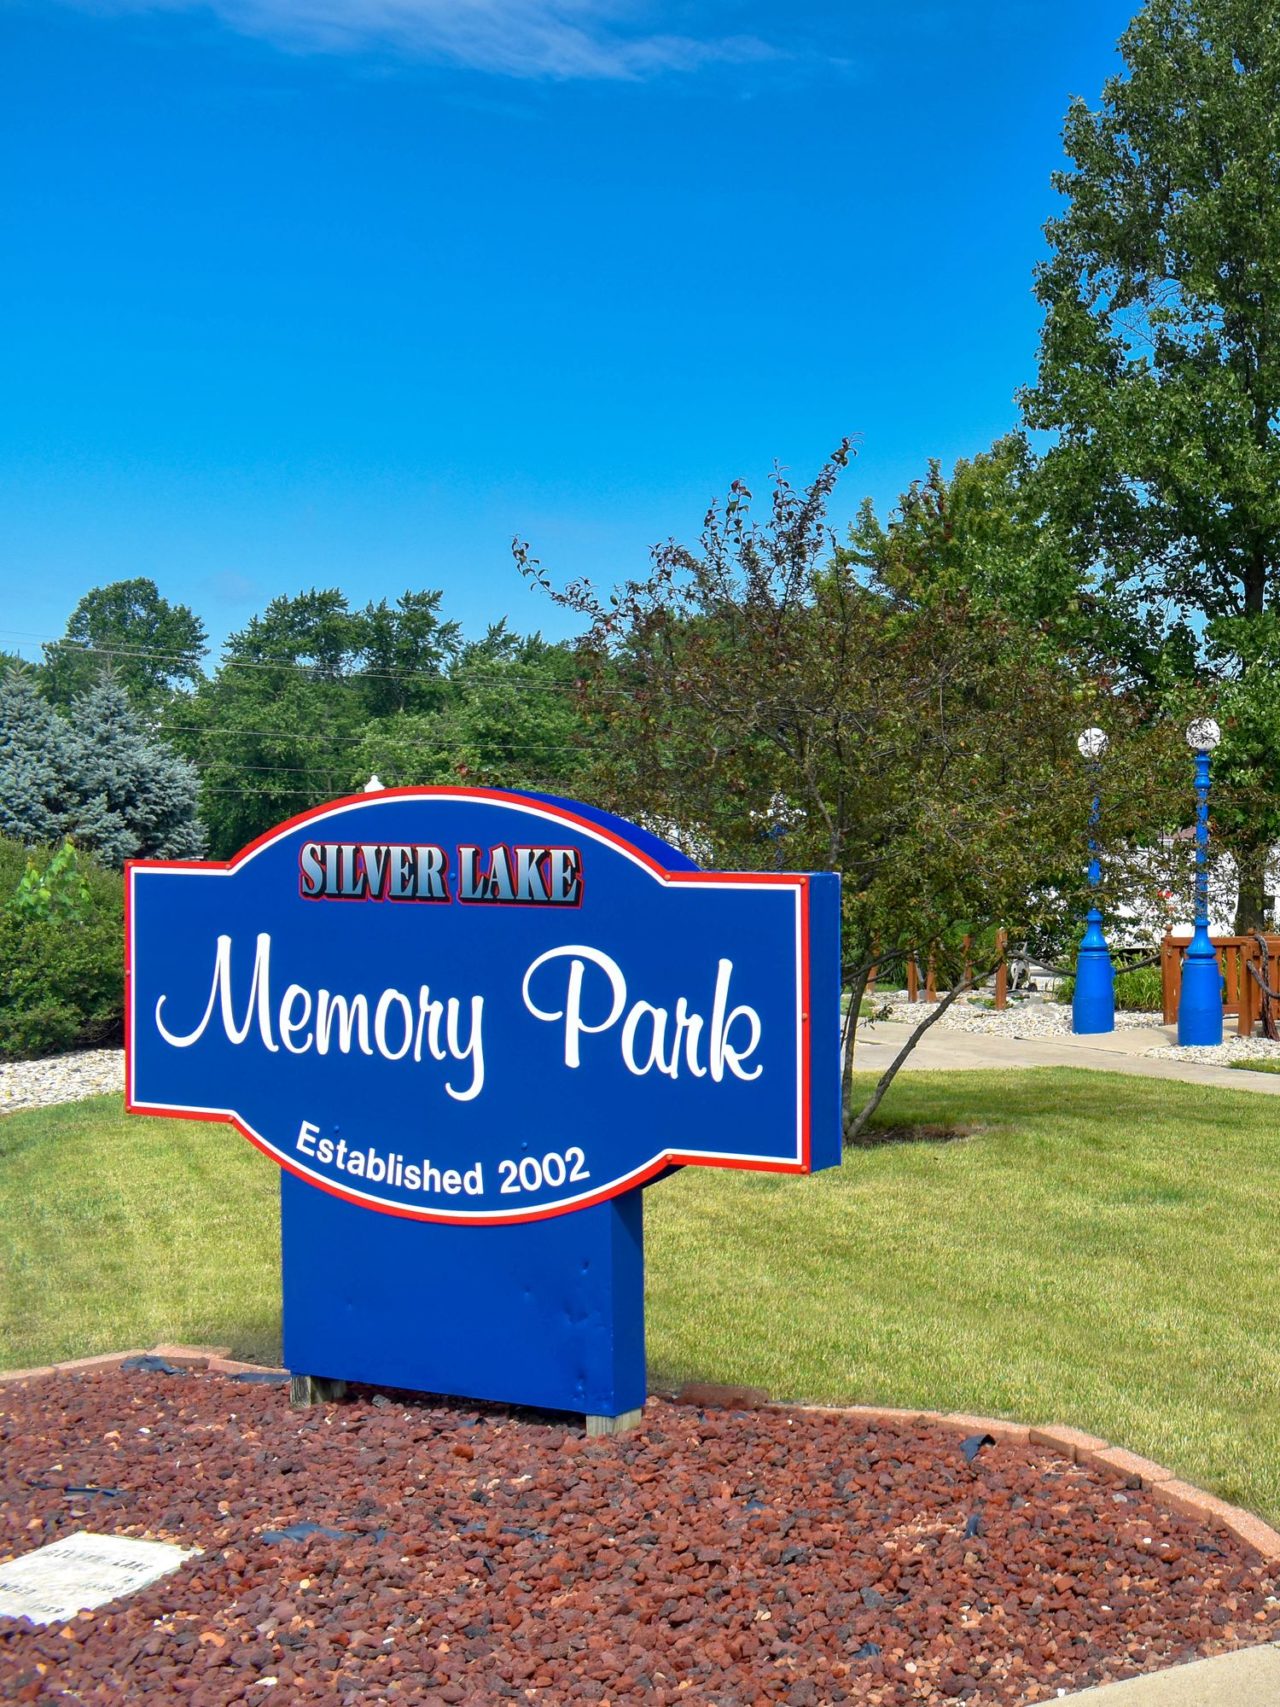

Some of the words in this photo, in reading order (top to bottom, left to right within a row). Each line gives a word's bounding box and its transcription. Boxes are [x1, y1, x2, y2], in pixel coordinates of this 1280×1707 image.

[300, 842, 451, 903] SILVER
[457, 843, 584, 908] LAKE
[155, 932, 485, 1102] Memory
[522, 944, 763, 1083] Park
[296, 1120, 484, 1195] Established
[498, 1146, 591, 1194] 2002
